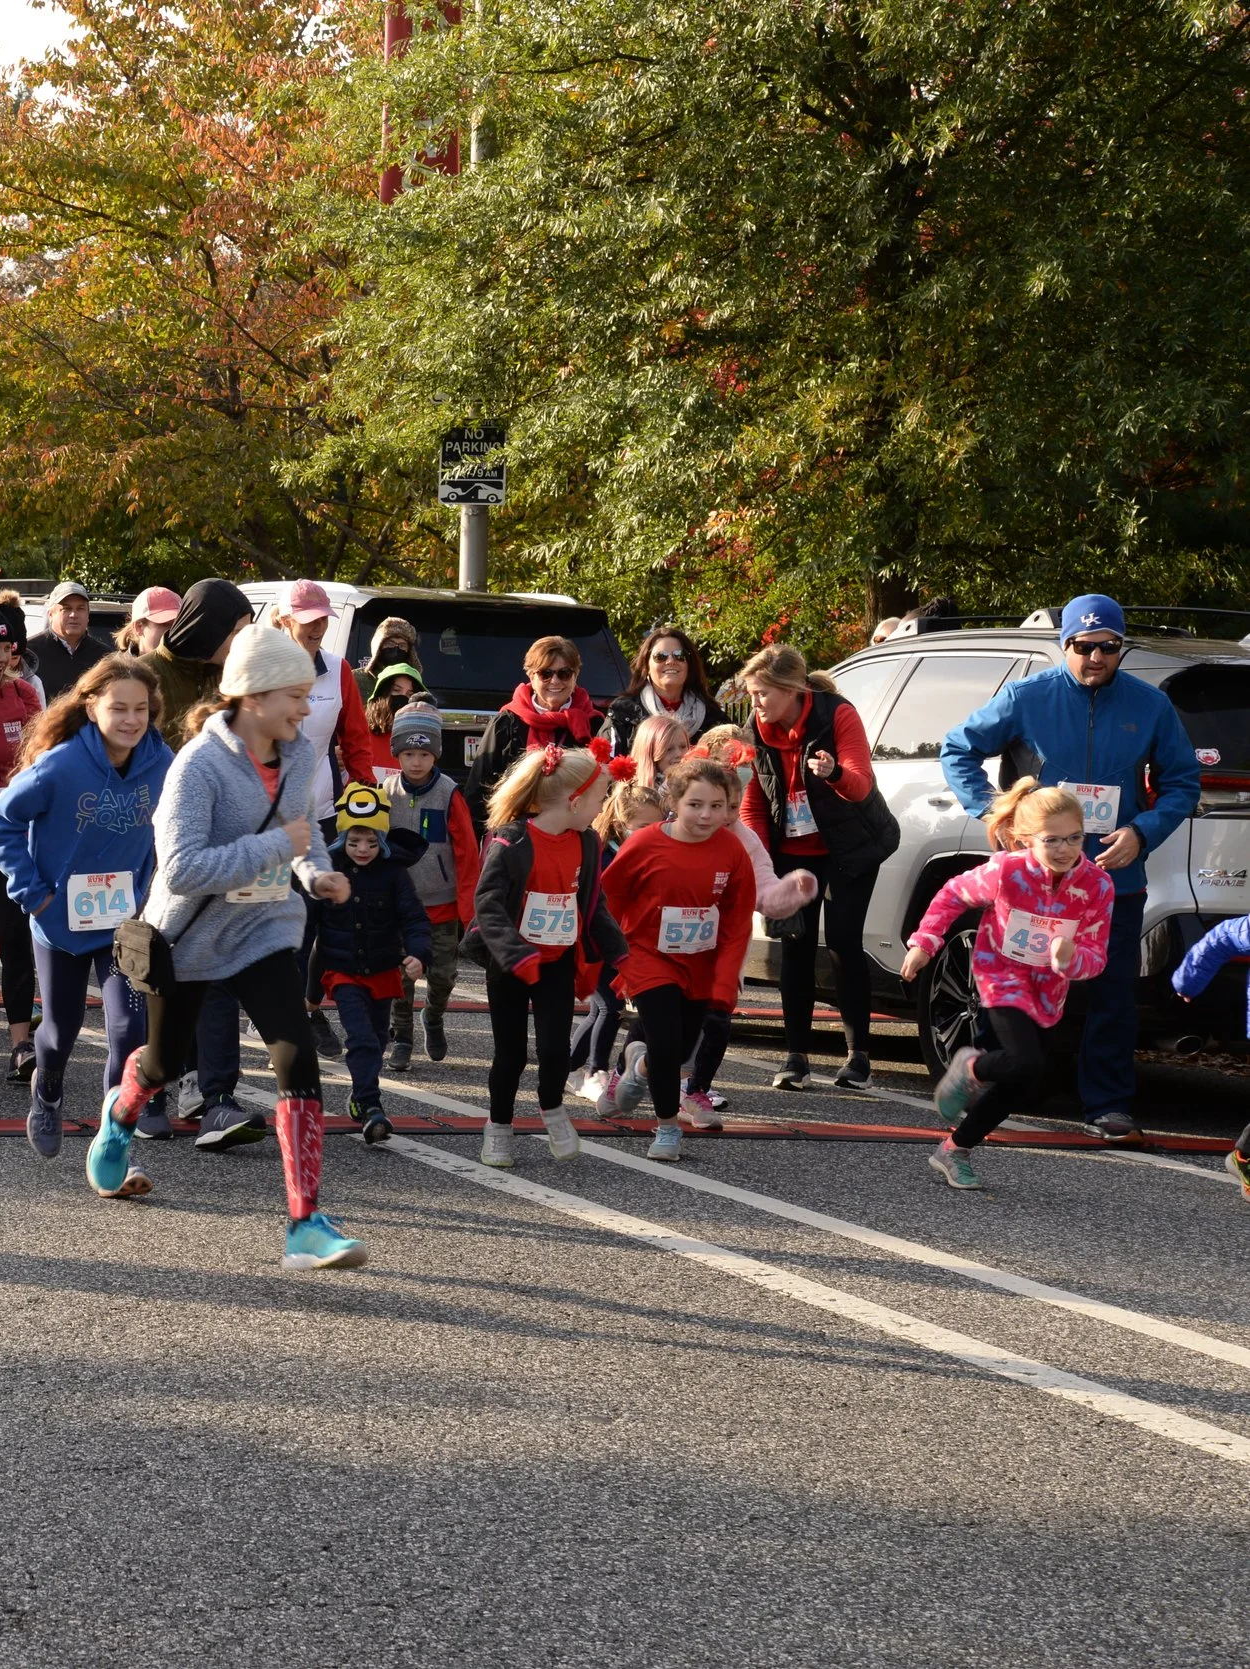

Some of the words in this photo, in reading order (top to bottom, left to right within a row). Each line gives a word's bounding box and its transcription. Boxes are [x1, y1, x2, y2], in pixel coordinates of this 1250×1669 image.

[464, 429, 485, 440] NO
[4, 726, 21, 734] RUN
[78, 785, 151, 815] CAVE
[1082, 801, 1112, 820] 40
[786, 805, 812, 825] 44
[257, 863, 291, 888] 98
[1199, 879, 1246, 887] PRIME
[74, 889, 130, 917] 614
[528, 908, 575, 932] 575
[665, 921, 714, 943] 578
[1010, 928, 1050, 953] 43
